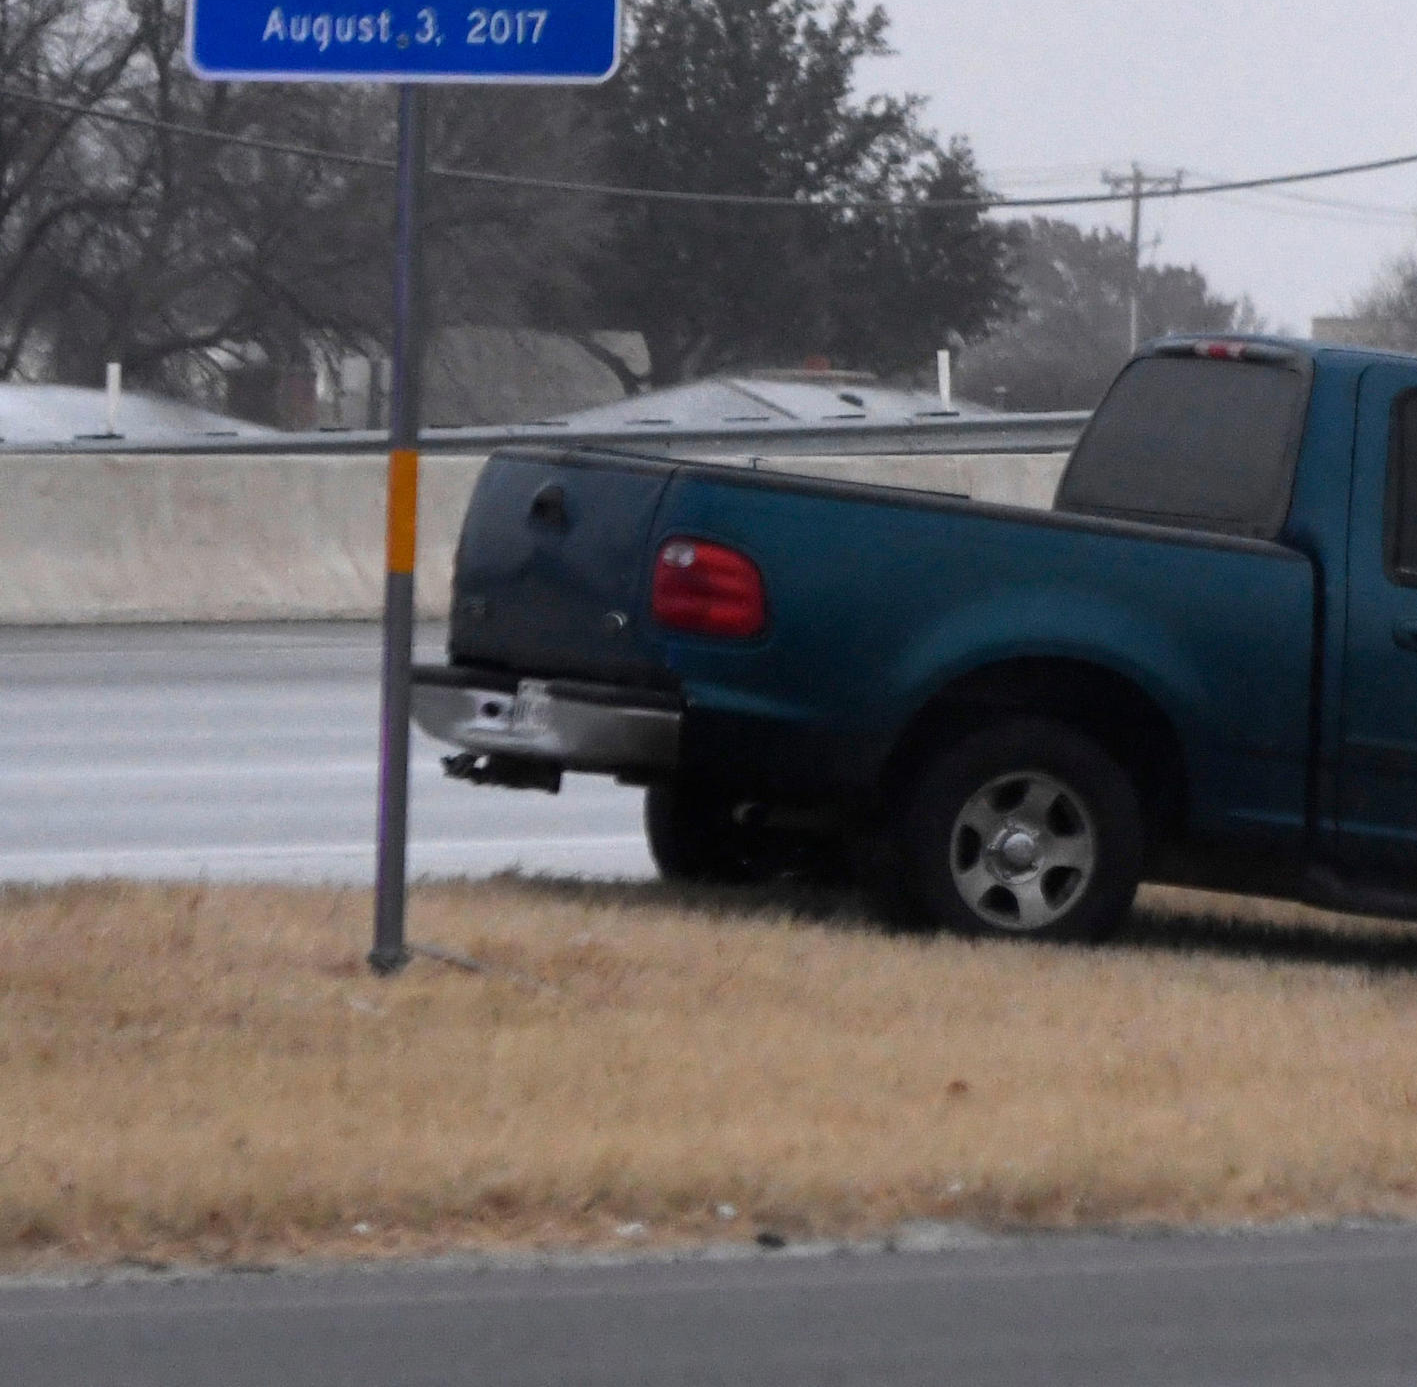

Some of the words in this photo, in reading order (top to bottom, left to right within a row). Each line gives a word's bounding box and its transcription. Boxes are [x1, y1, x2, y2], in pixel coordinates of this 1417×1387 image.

[262, 7, 391, 52] August
[416, 9, 442, 46] 3,
[467, 9, 548, 45] 2017
